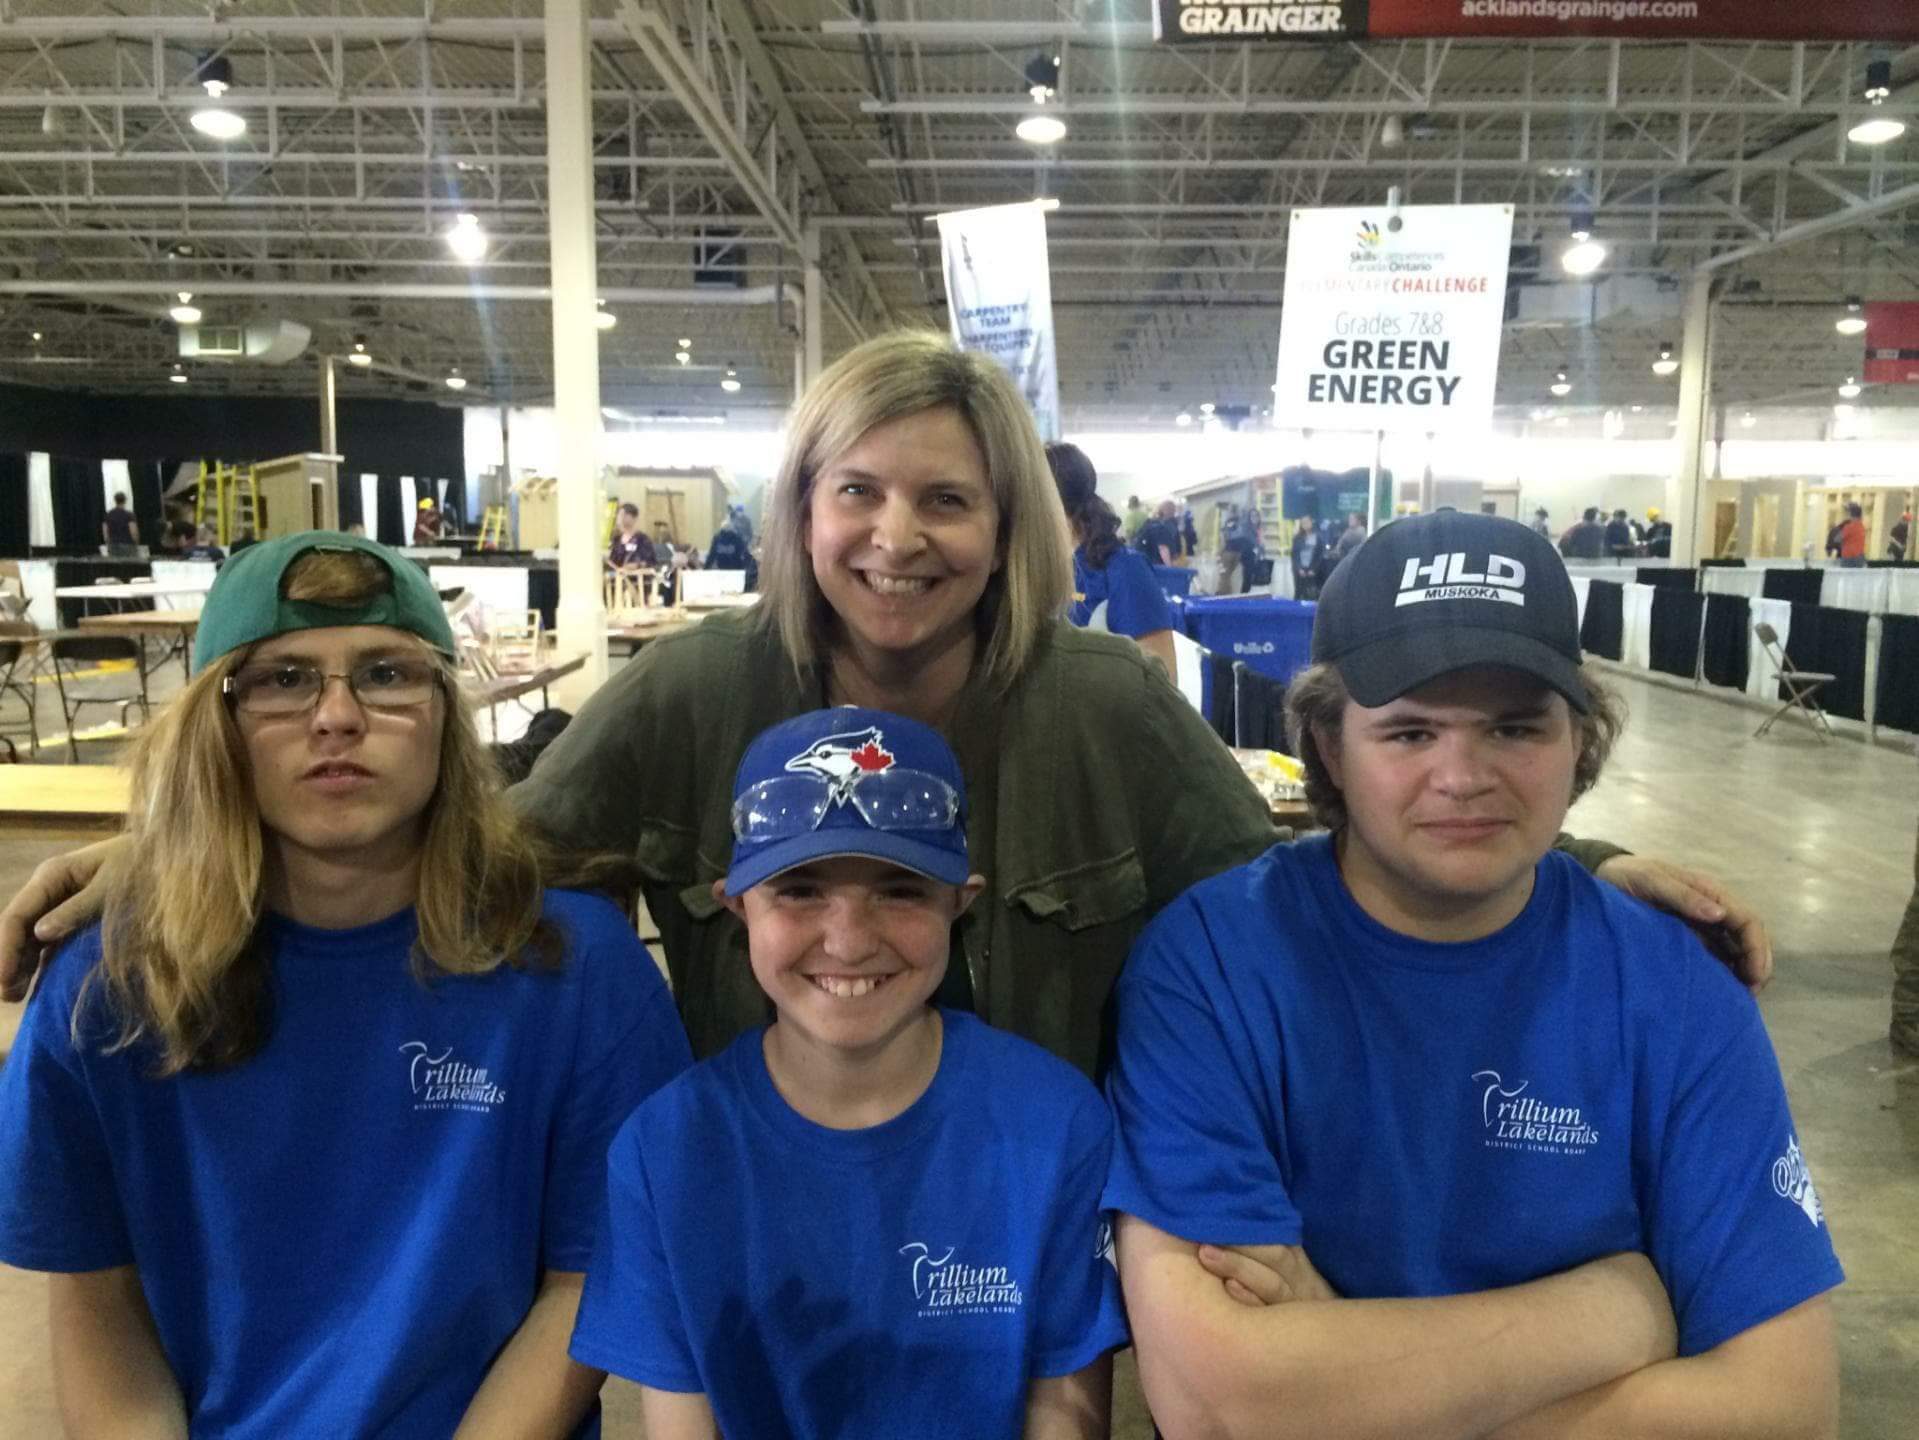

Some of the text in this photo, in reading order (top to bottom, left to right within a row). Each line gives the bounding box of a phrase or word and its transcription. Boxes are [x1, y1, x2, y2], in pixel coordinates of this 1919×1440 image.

[1180, 5, 1341, 34] GRAINGER
[1461, 0, 1698, 20] acklandsgrainger.com
[1389, 262, 1432, 273] Ontario
[1392, 277, 1488, 294] CHALLENGE
[980, 317, 1010, 328] TEAM
[1335, 311, 1444, 336] Grades 7&8
[1323, 339, 1450, 370] GREEN
[1308, 374, 1462, 406] ENERGY
[1400, 552, 1526, 589] HLD
[1424, 586, 1500, 600] MUSKOKA
[1471, 1070, 1580, 1128] Trillium
[1497, 1121, 1599, 1145] Lakelands
[899, 1242, 1008, 1300] Trillium
[929, 1281, 1023, 1307] Lakelands
